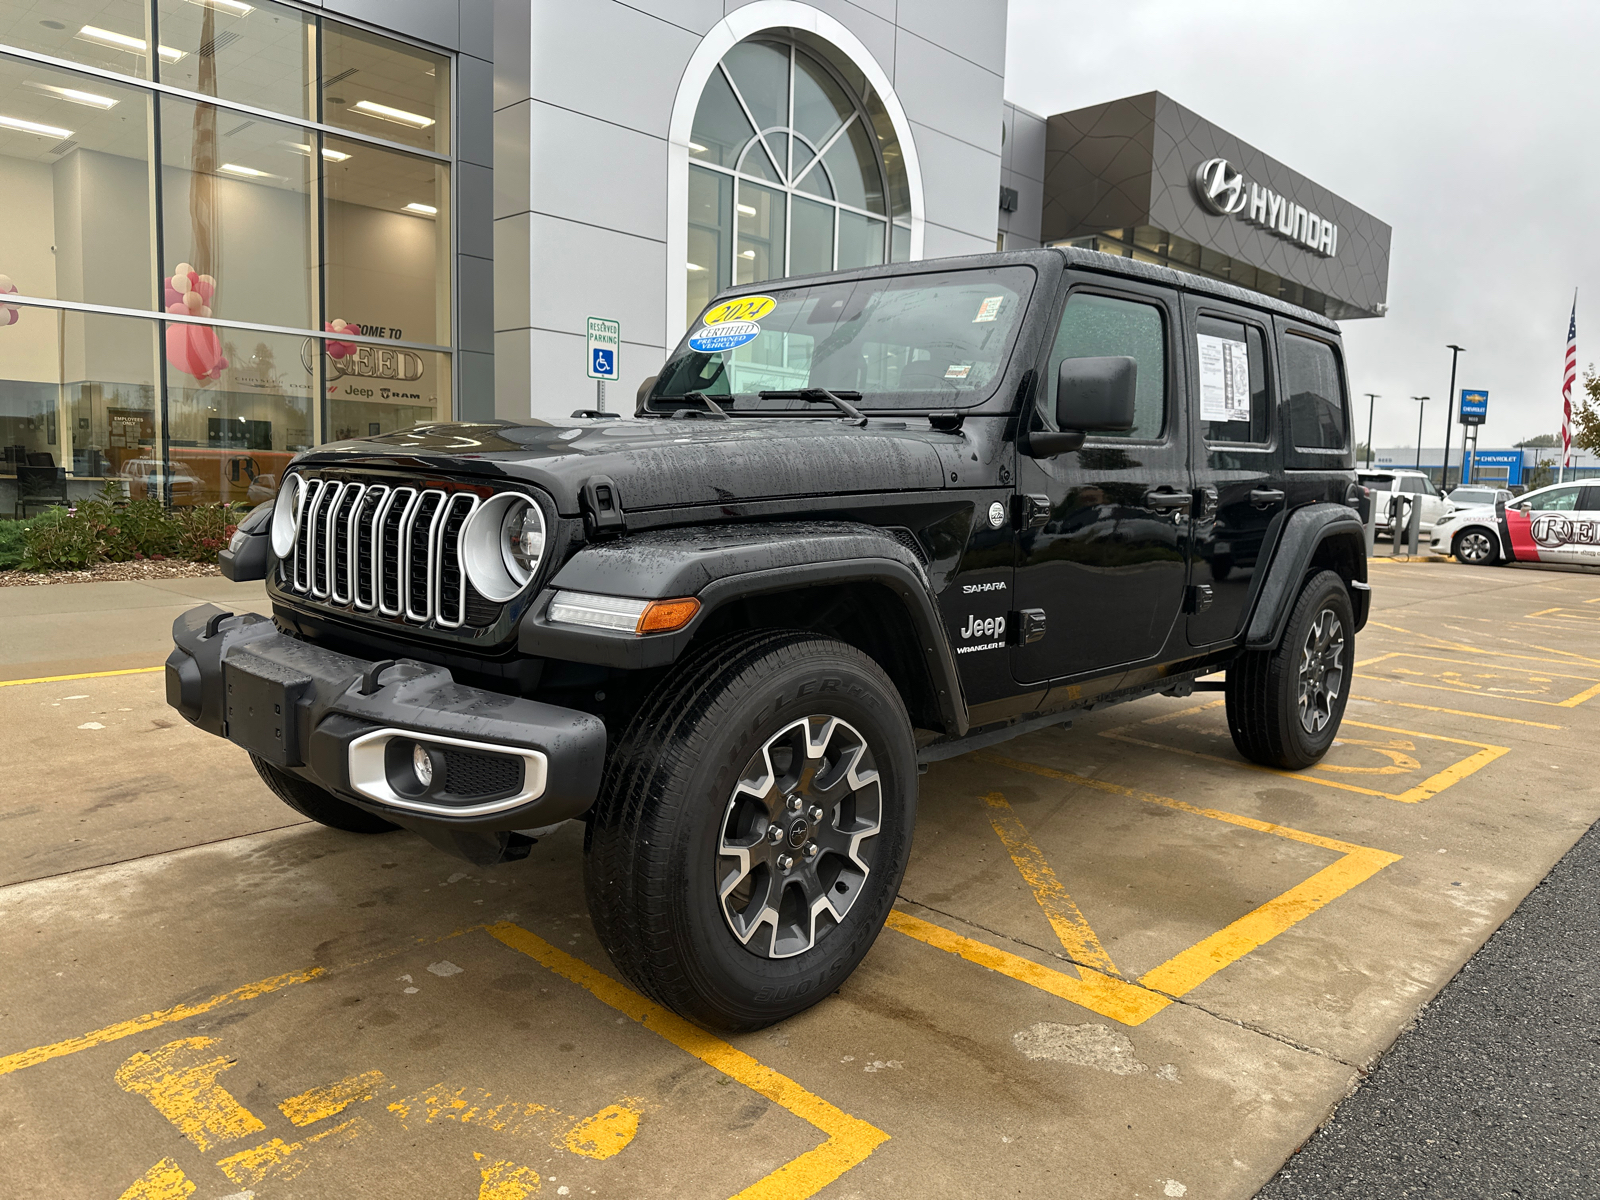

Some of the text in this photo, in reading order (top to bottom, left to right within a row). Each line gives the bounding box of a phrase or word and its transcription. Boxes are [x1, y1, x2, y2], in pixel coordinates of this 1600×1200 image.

[1250, 182, 1338, 258] HYUNDAI
[710, 300, 769, 323] 2024
[389, 328, 402, 340] TO
[590, 322, 617, 335] RESERVED
[699, 324, 755, 338] CERTIFIED
[590, 332, 618, 345] PARKING
[697, 335, 747, 345] PRE-OWNED
[702, 341, 736, 349] VEHICLE
[345, 385, 374, 398] Jeep
[392, 392, 420, 400] RAM
[962, 581, 1007, 594] SAHARA
[960, 614, 1006, 639] Jeep
[956, 642, 998, 655] WRANGLER
